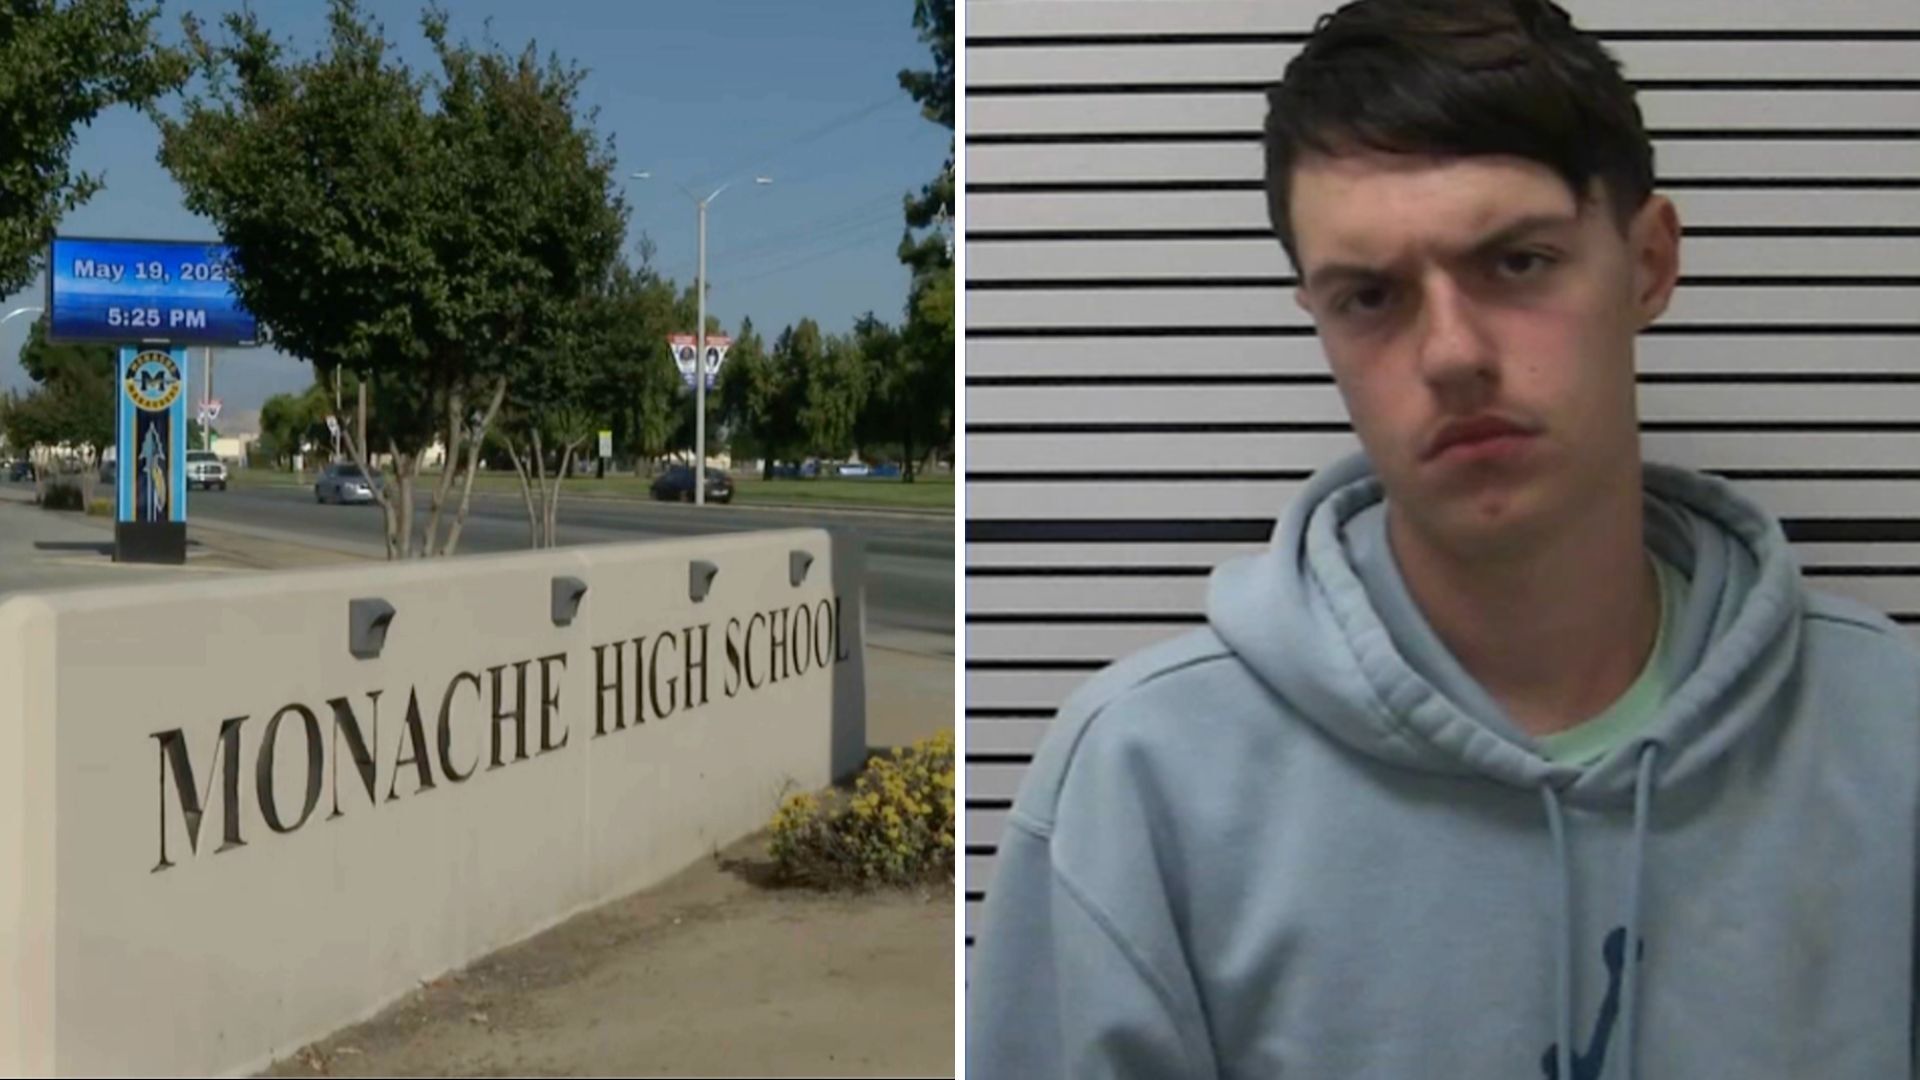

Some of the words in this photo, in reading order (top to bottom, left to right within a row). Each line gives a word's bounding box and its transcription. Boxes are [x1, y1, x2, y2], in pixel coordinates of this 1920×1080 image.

[74, 259, 124, 283] May
[135, 261, 170, 283] 19,
[107, 307, 160, 327] 5:25
[169, 309, 206, 328] PM
[141, 370, 165, 391] M
[149, 651, 570, 873] MONACHE
[590, 623, 711, 739] HIGH
[724, 596, 850, 699] SCHOOL
